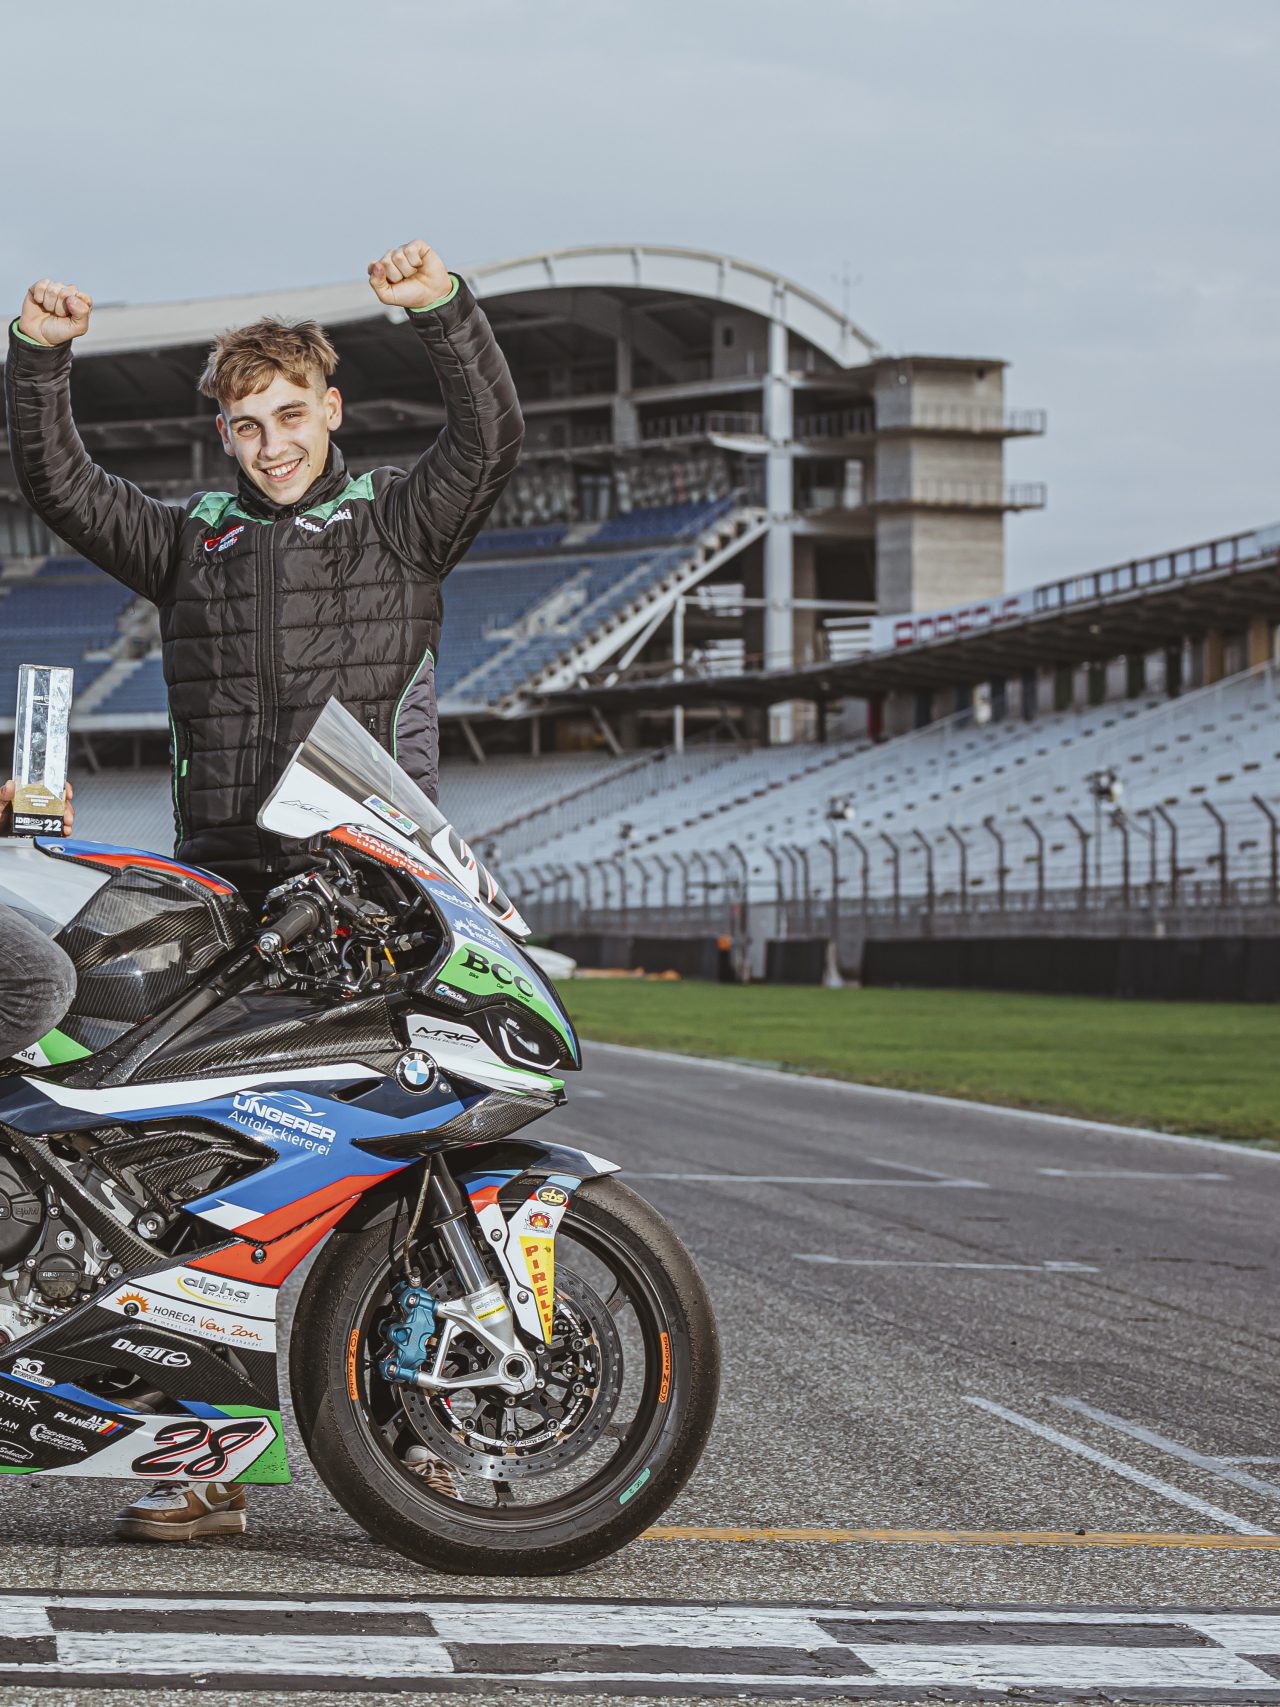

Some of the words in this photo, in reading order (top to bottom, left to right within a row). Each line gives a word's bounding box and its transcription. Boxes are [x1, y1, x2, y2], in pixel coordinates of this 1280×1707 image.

[44, 819, 62, 832] 22
[346, 828, 432, 876] CHAMPION
[356, 838, 418, 874] LUBRICANTS
[459, 947, 533, 998] BCC
[412, 1033, 441, 1042] MOTORCYCLE
[415, 1026, 480, 1044] MRP
[402, 1053, 435, 1069] BMW
[228, 1110, 331, 1156] Autolackiererei
[233, 1094, 337, 1143] UNGERER
[540, 1189, 565, 1203] sbs
[183, 1275, 251, 1300] alpha
[207, 1292, 248, 1304] RACING
[525, 1244, 552, 1335] PIRELLI
[153, 1305, 196, 1324] HORECA
[199, 1314, 226, 1334] Van
[230, 1324, 263, 1341] Zon
[348, 1362, 356, 1396] RACING
[131, 1420, 268, 1479] 28
